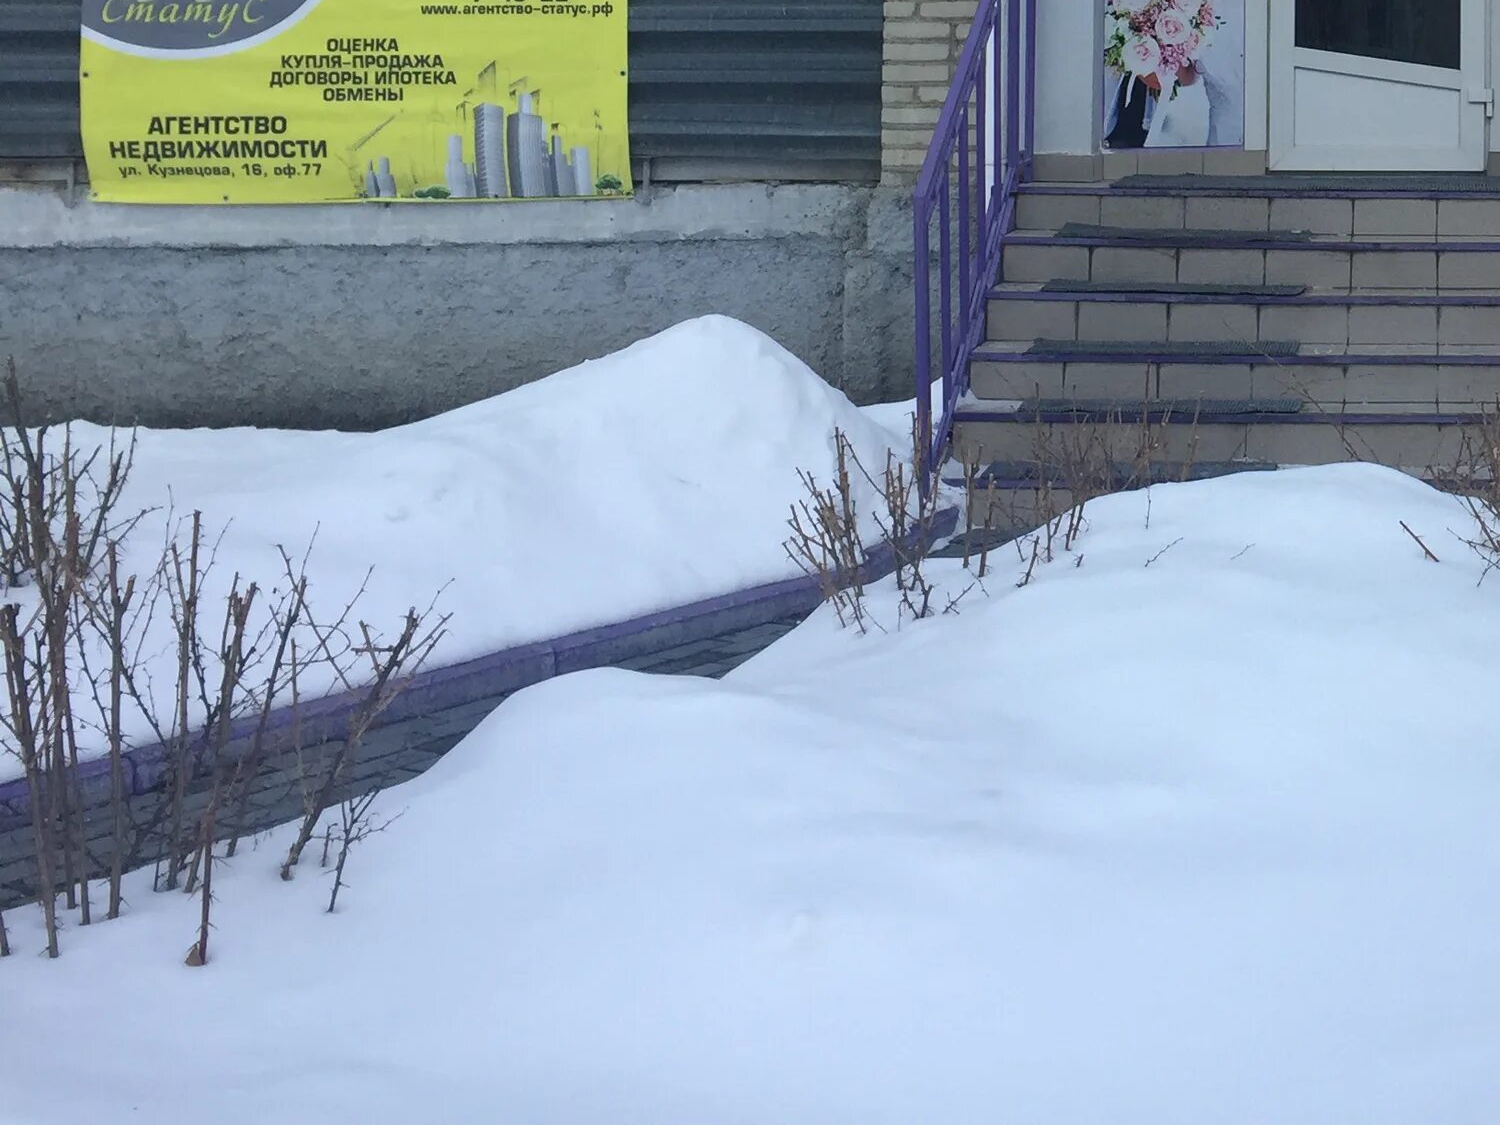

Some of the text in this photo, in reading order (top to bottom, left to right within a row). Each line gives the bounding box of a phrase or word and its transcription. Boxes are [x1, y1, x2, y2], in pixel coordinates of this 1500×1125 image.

[420, 1, 614, 17] www.агентство-статус.рф
[326, 38, 399, 54] ОЦЕНКА
[281, 54, 444, 70] КУПЛЯ-ПРОДАЖА
[269, 70, 457, 87] ДОГОВОРЫ ИПОТЕКА
[322, 87, 404, 101] ОБМЕНЫ
[147, 116, 288, 135] АГЕНТСТВО
[109, 140, 328, 162] НЕДВИЖИМОСТИ
[118, 163, 322, 179] ул. Кузнецова, 16, оф.77
